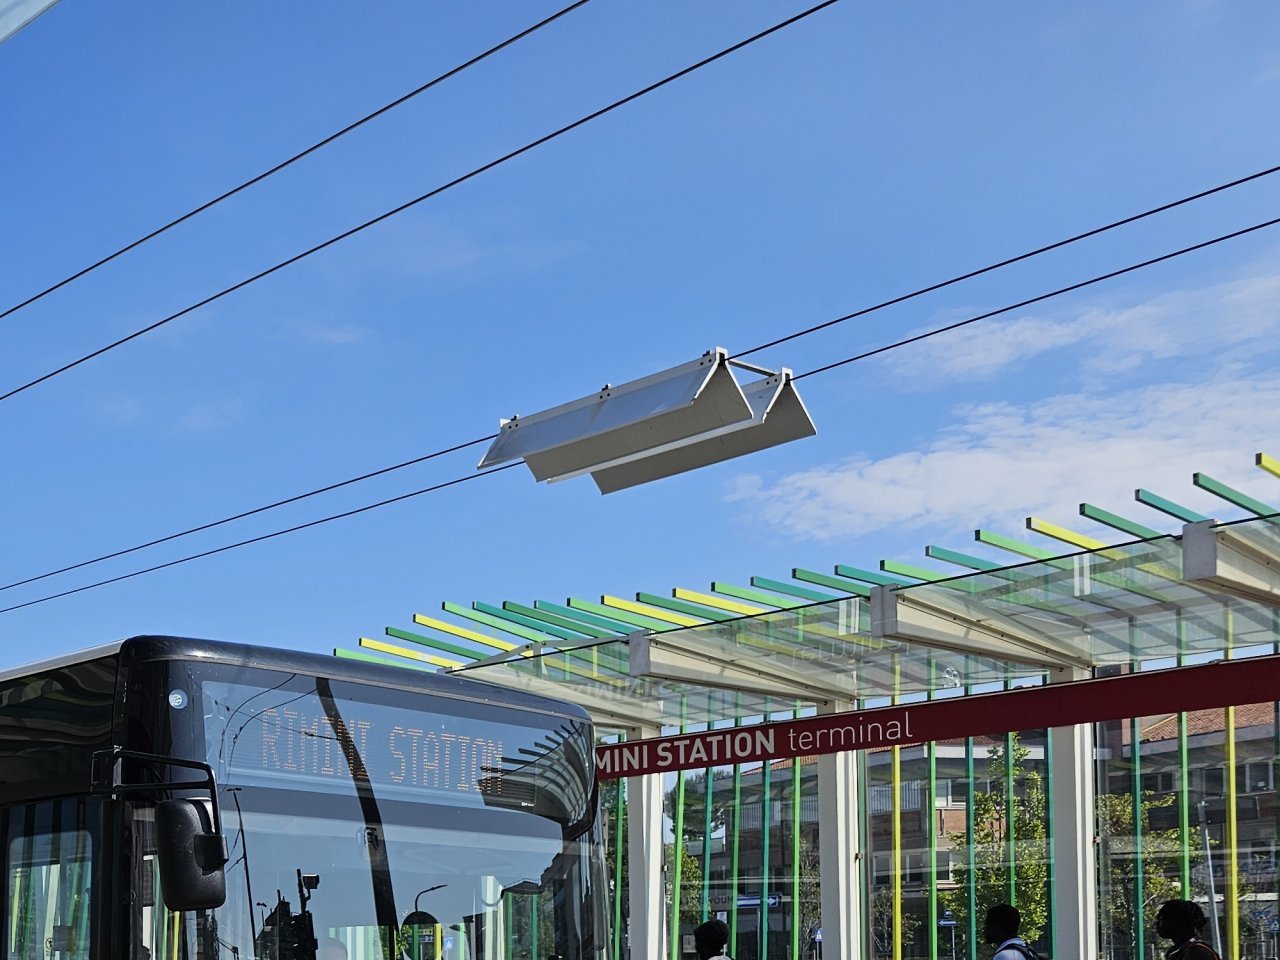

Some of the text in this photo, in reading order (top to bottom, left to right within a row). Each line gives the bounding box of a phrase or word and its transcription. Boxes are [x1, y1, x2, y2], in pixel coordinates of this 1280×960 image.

[261, 707, 503, 795] RIMINI STATION
[656, 728, 775, 767] STATION
[787, 711, 913, 752] terminal
